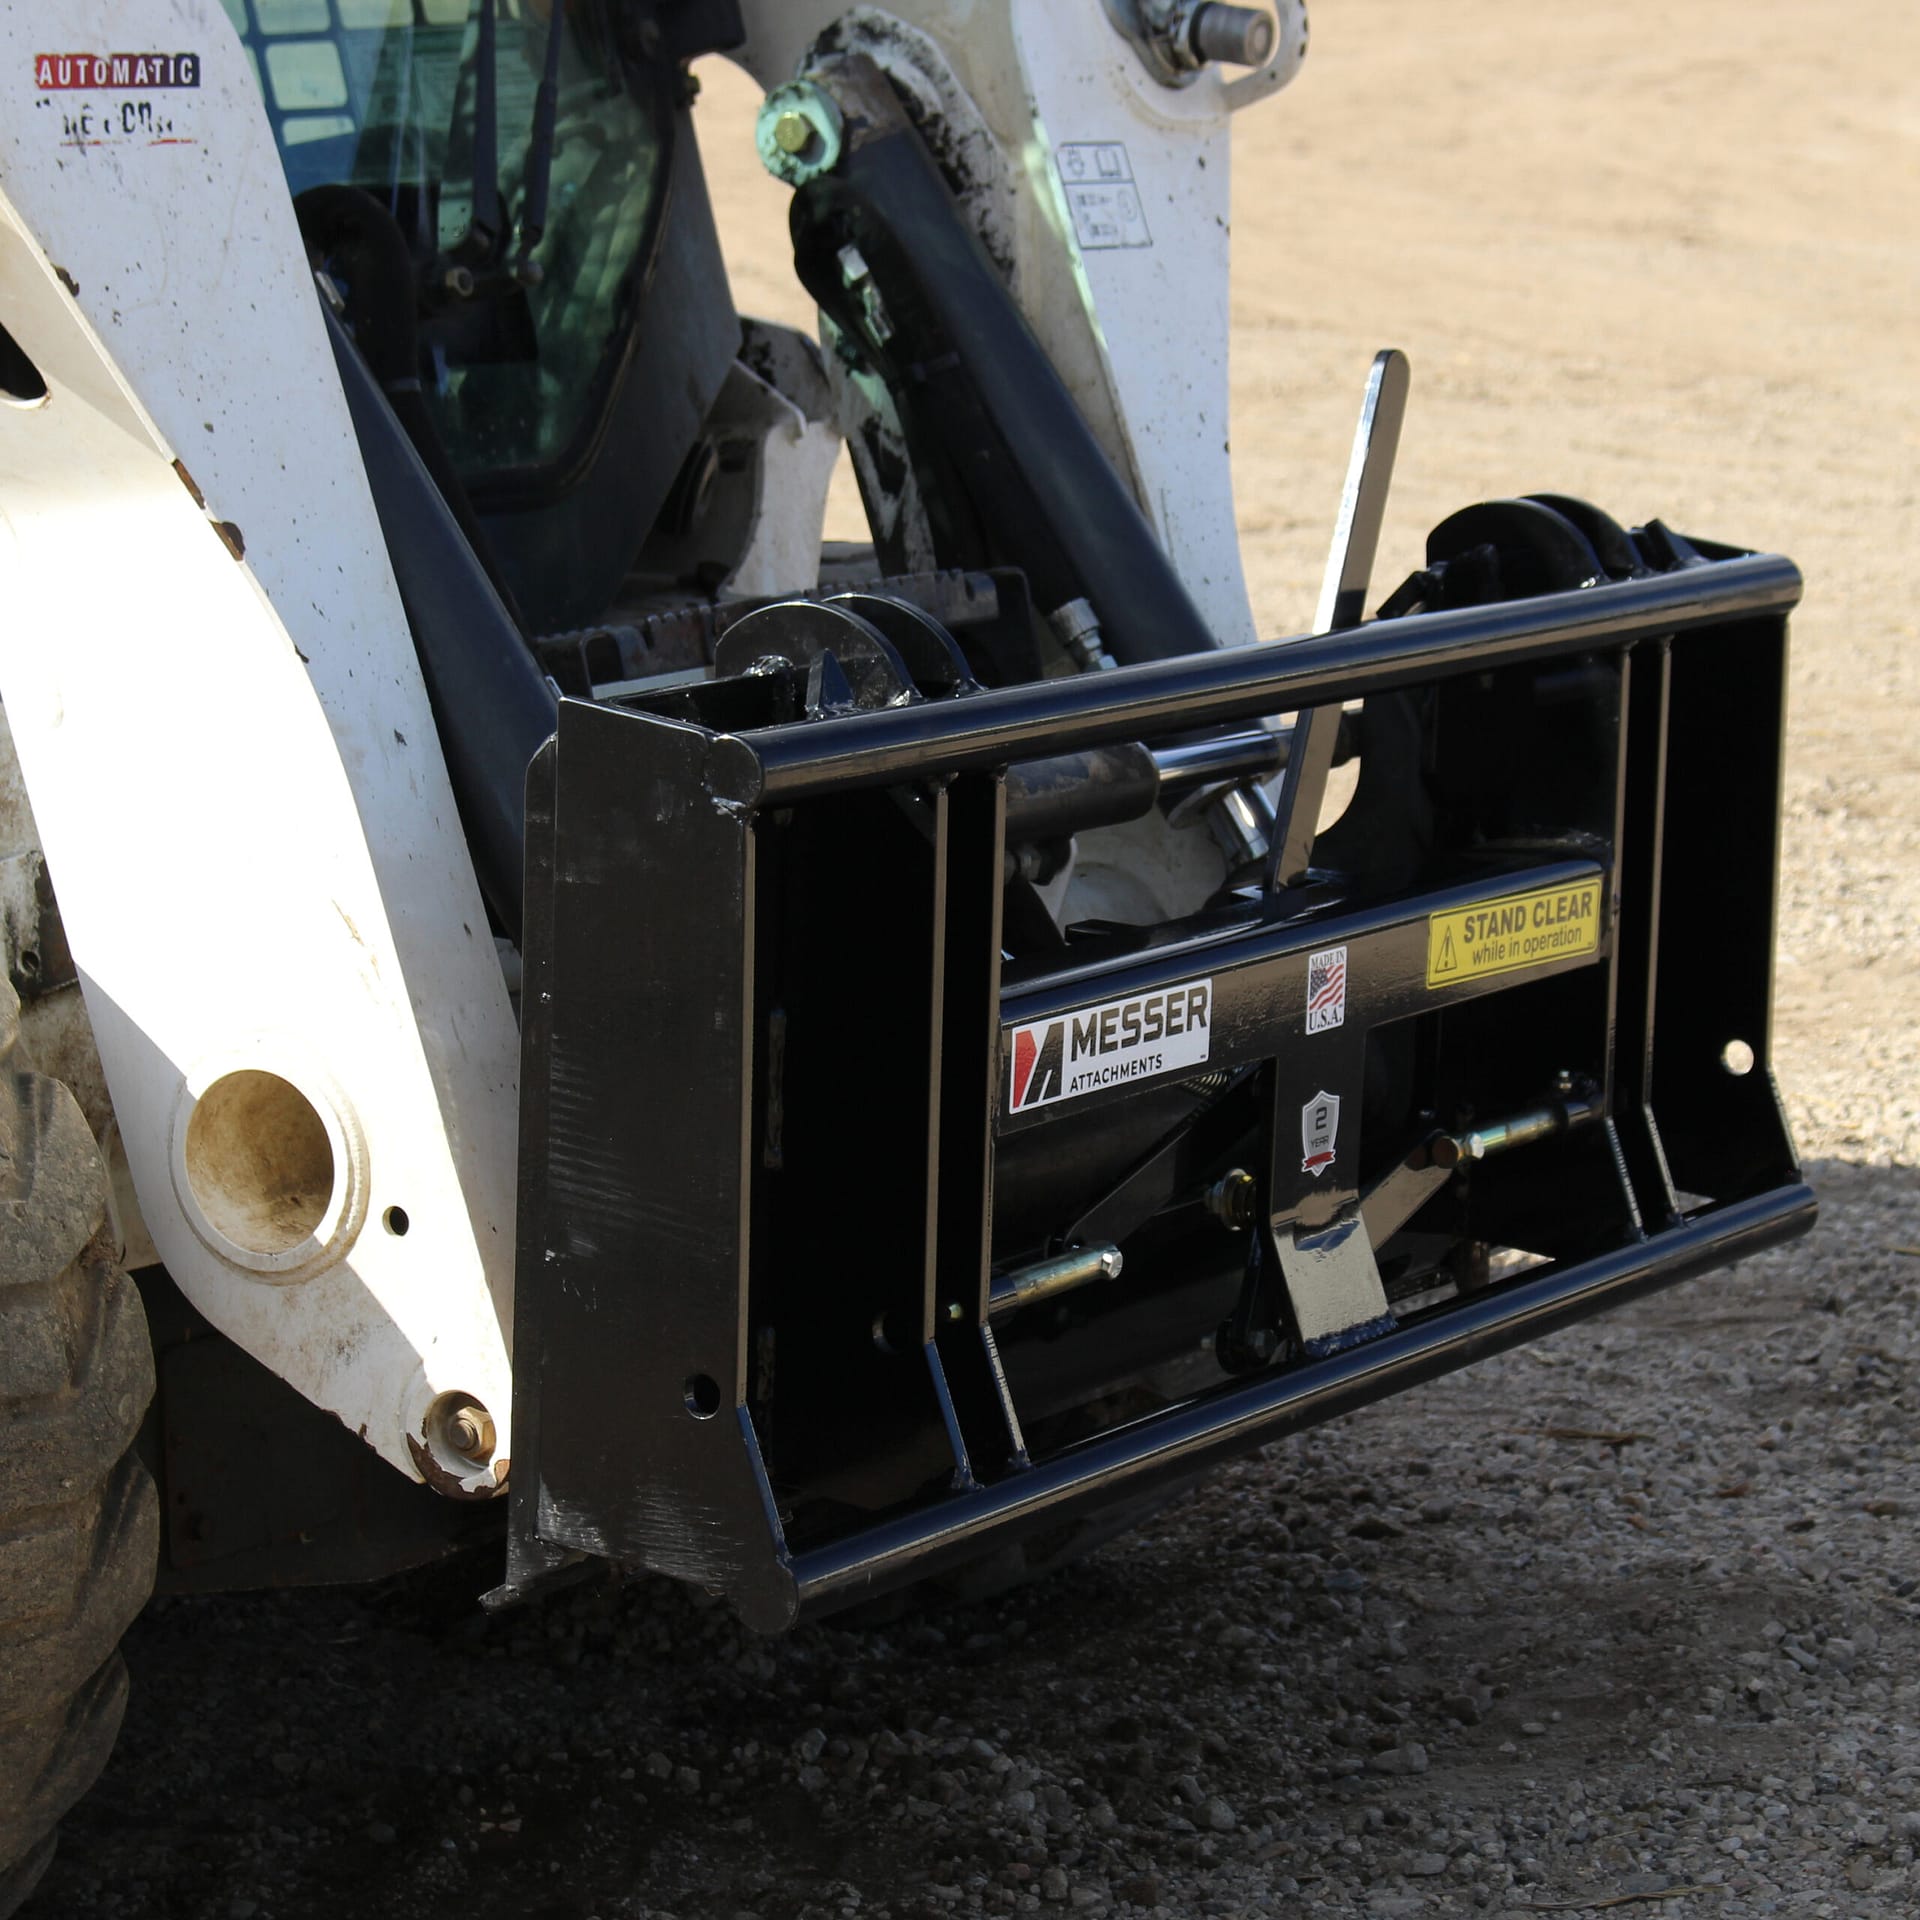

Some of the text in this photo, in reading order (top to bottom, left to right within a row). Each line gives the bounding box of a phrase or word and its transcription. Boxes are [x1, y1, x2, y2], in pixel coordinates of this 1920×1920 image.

[38, 57, 194, 86] AUTOMATIC
[1463, 891, 1593, 943] STAND CLEAR
[1312, 953, 1334, 968] MADE
[1472, 927, 1582, 966] while in operation
[1071, 986, 1208, 1061] MESSER
[1069, 1053, 1163, 1092] ATTACHMENTS
[1315, 1106, 1328, 1131] 2
